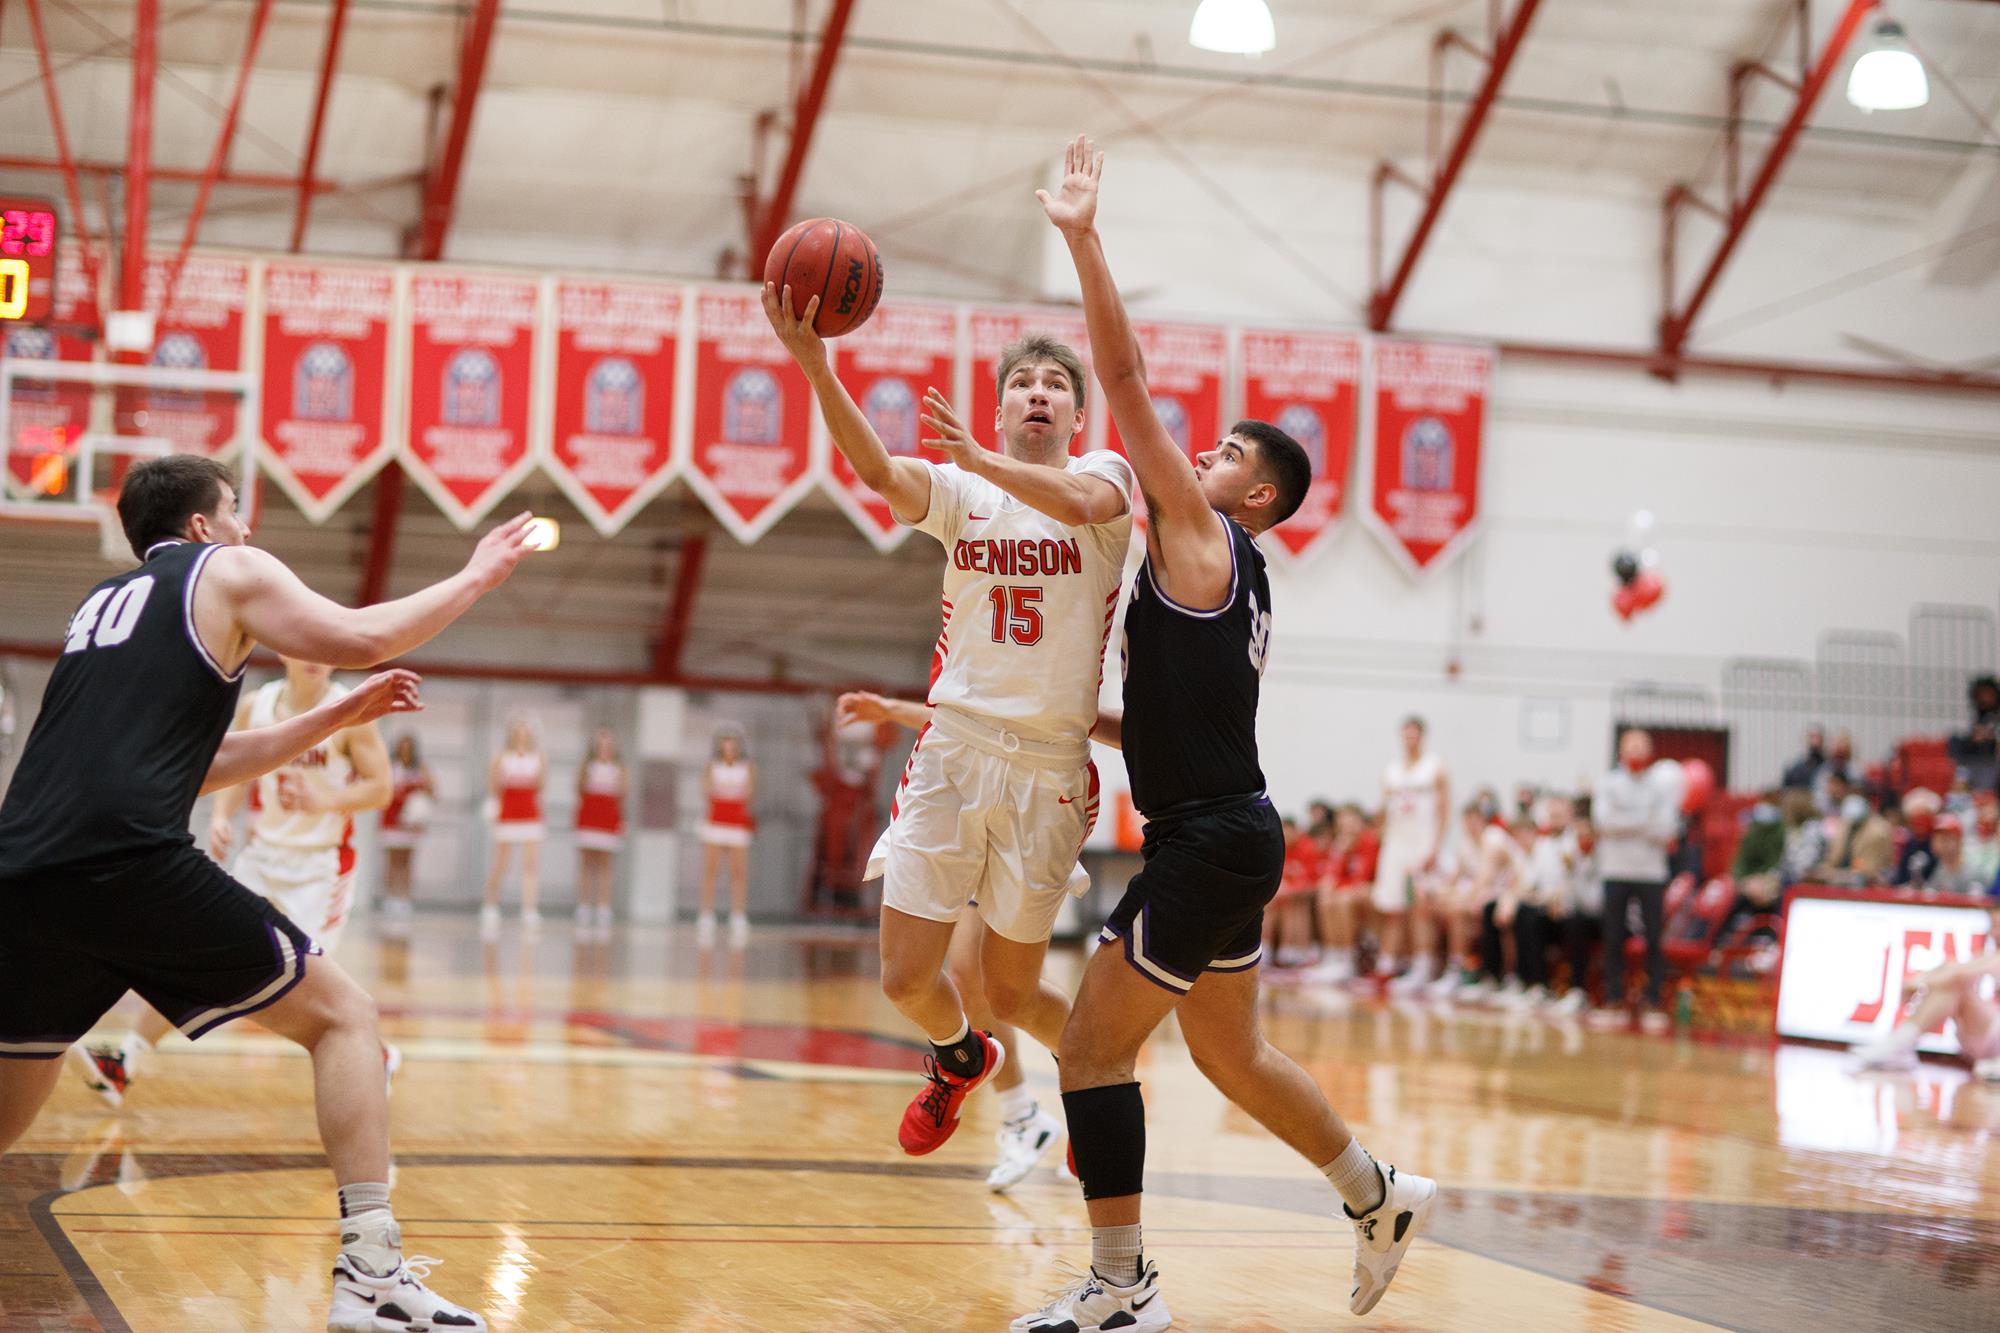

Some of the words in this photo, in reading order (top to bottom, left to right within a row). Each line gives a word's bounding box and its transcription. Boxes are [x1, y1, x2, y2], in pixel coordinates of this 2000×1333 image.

[835, 257, 864, 314] NCAA
[953, 537, 1082, 576] DENISON
[64, 574, 155, 654] 40
[988, 585, 1043, 646] 15
